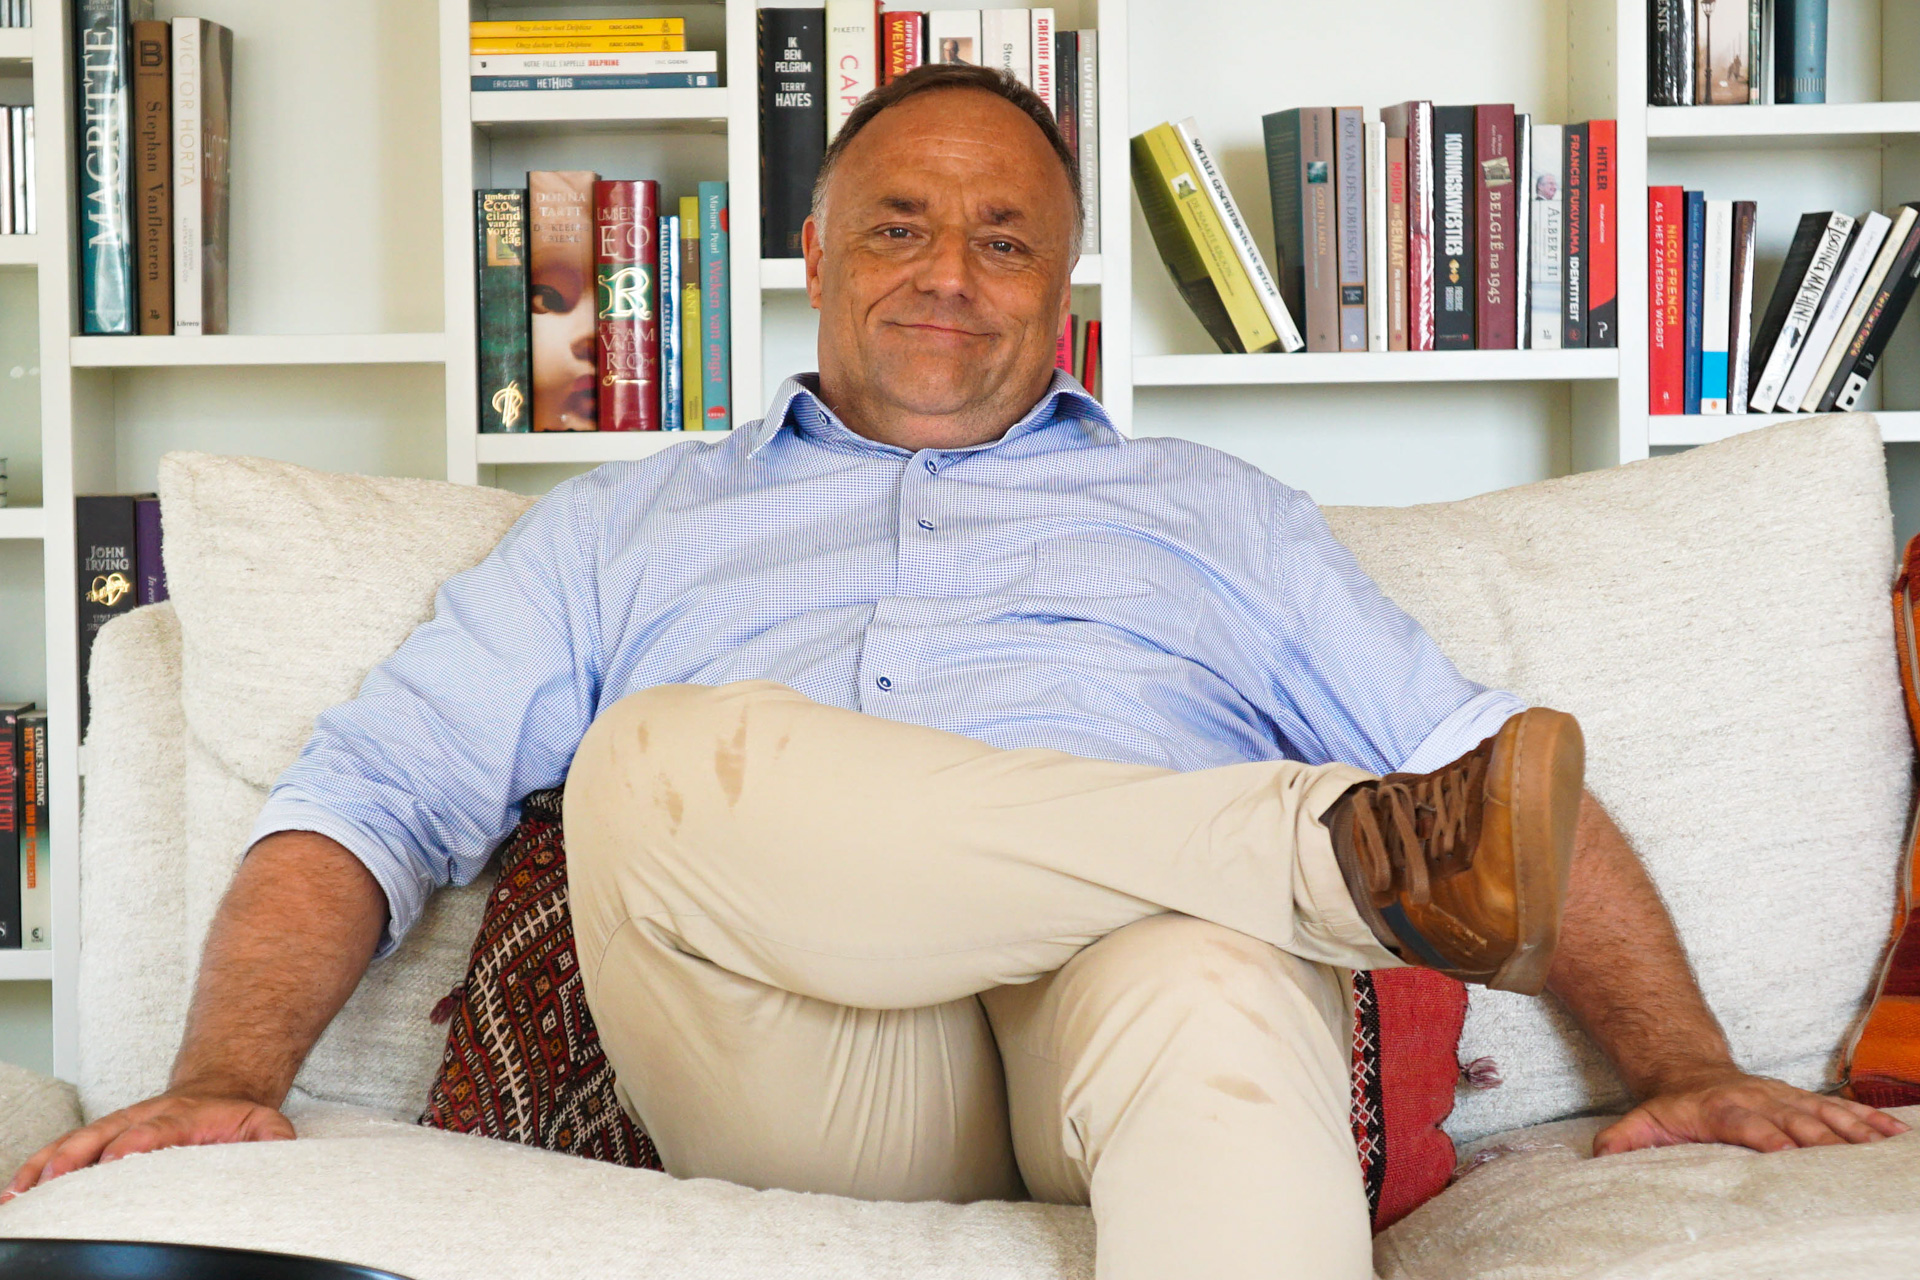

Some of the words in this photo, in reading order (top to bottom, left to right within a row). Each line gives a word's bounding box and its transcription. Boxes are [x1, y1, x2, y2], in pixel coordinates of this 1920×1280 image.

[787, 36, 798, 49] IK
[832, 26, 866, 34] PIKETTY
[1038, 18, 1050, 60] CREATIEF
[178, 33, 195, 110] VICTOR
[774, 60, 813, 75] PELGRIM
[783, 48, 802, 61] BEN
[774, 92, 813, 108] HAYES
[780, 81, 806, 93] TERRY
[1082, 57, 1094, 128] LUYENDIJK
[83, 25, 122, 250] MAGRITTE
[142, 101, 162, 173] Stephan
[178, 119, 195, 188] HORTA
[1570, 134, 1580, 187] FRANCIS
[1596, 146, 1609, 191] HITLER
[483, 199, 511, 212] eco
[536, 192, 586, 203] DONNA
[1345, 174, 1357, 205] DEN
[1444, 132, 1464, 257] KONINGSKWESTIES
[485, 210, 521, 221] eiland
[487, 220, 505, 228] van
[505, 220, 518, 228] de
[539, 206, 583, 217] TARTT
[1489, 191, 1505, 251] BELGIË
[1569, 188, 1580, 256] FUKUYAMA
[1654, 200, 1664, 222] ALS
[146, 183, 164, 282] Vanfleteren
[486, 227, 521, 238] vorige
[501, 234, 522, 247] dag
[710, 232, 720, 254] Pearl
[1390, 218, 1404, 268] SENAAT
[1547, 206, 1561, 262] ALBERT
[1655, 223, 1664, 245] HET
[1666, 223, 1678, 263] NICCI
[1490, 252, 1500, 269] na
[1655, 248, 1664, 306] ZATERDAG
[685, 282, 696, 318] KANT
[709, 259, 723, 309] Weken
[1487, 272, 1502, 304] 1945
[1569, 256, 1580, 322] IDENTITEIT
[1667, 267, 1679, 326] FRENCH
[711, 314, 721, 339] van
[1655, 308, 1664, 349] WORDT
[708, 343, 722, 383] angst
[85, 558, 130, 571] IRVING
[90, 545, 125, 559] JOHN
[23, 726, 34, 750] HET
[35, 726, 45, 761] CLAIRE
[24, 750, 35, 802] NETWERK
[35, 762, 45, 806] STERLING
[25, 805, 36, 824] VAN
[26, 825, 36, 840] DE
[26, 840, 37, 889] TERREUR
